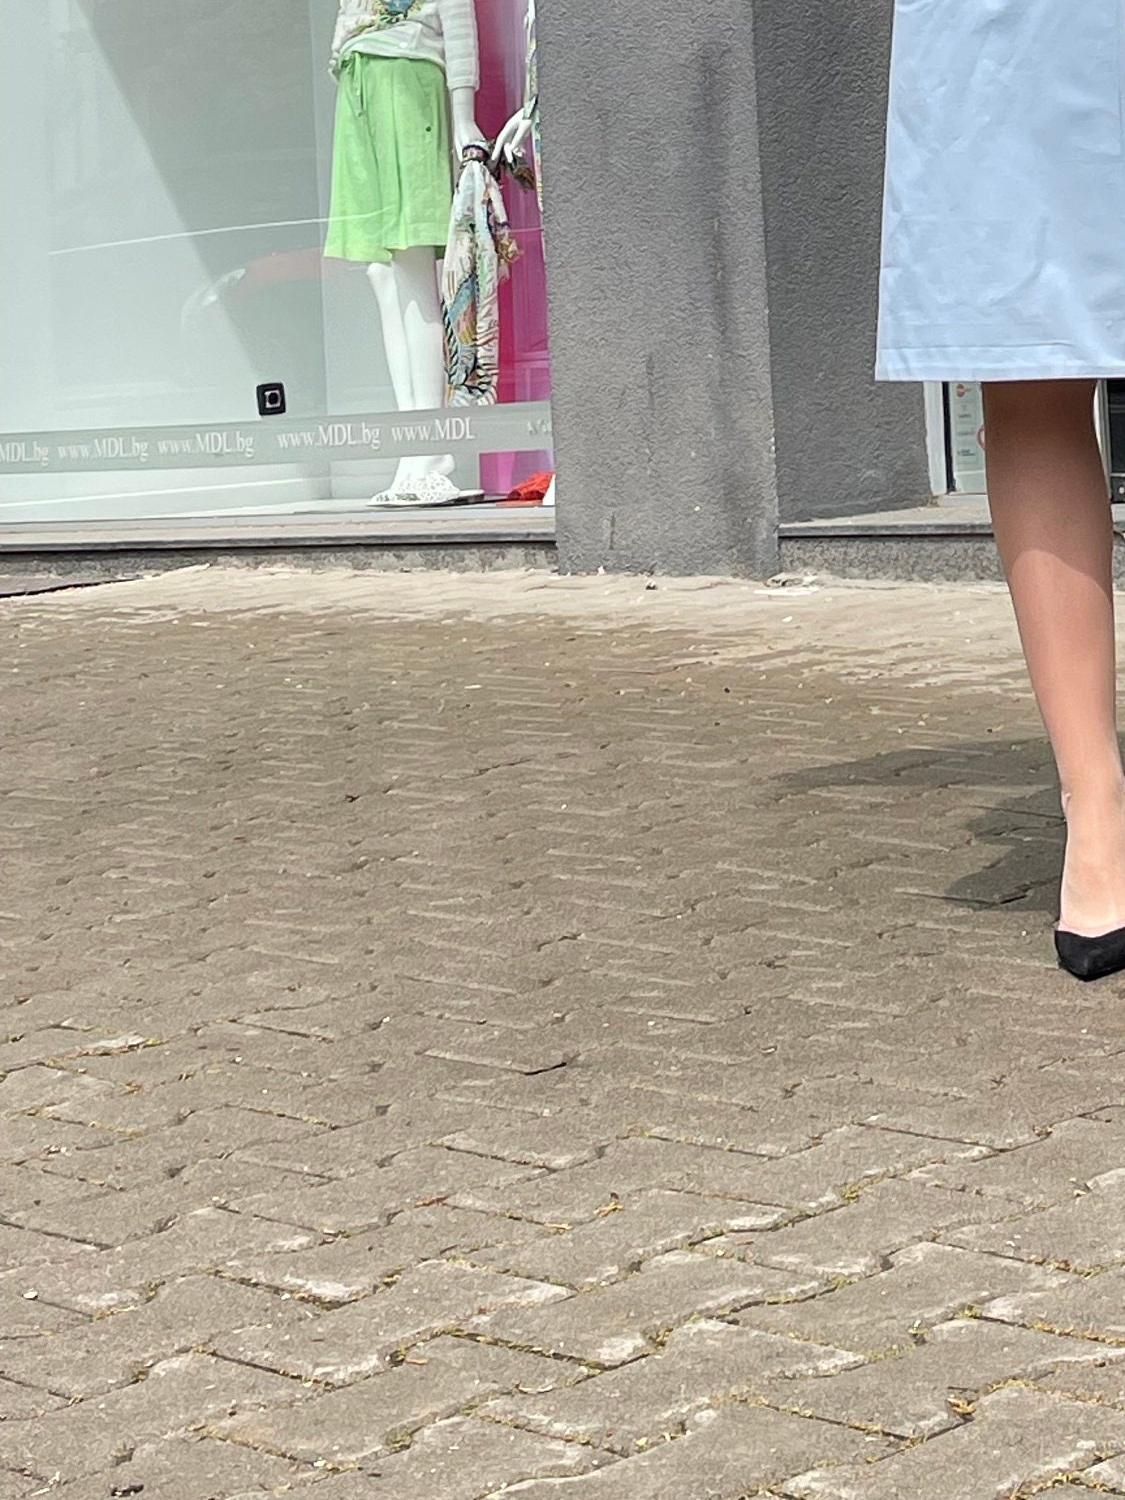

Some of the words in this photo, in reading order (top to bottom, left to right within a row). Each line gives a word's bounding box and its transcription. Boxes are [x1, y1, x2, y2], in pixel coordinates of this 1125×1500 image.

[57, 436, 148, 462] www.MDL.bg
[157, 431, 254, 457] www.MDL.bg
[277, 422, 381, 449] www.MDL.bg
